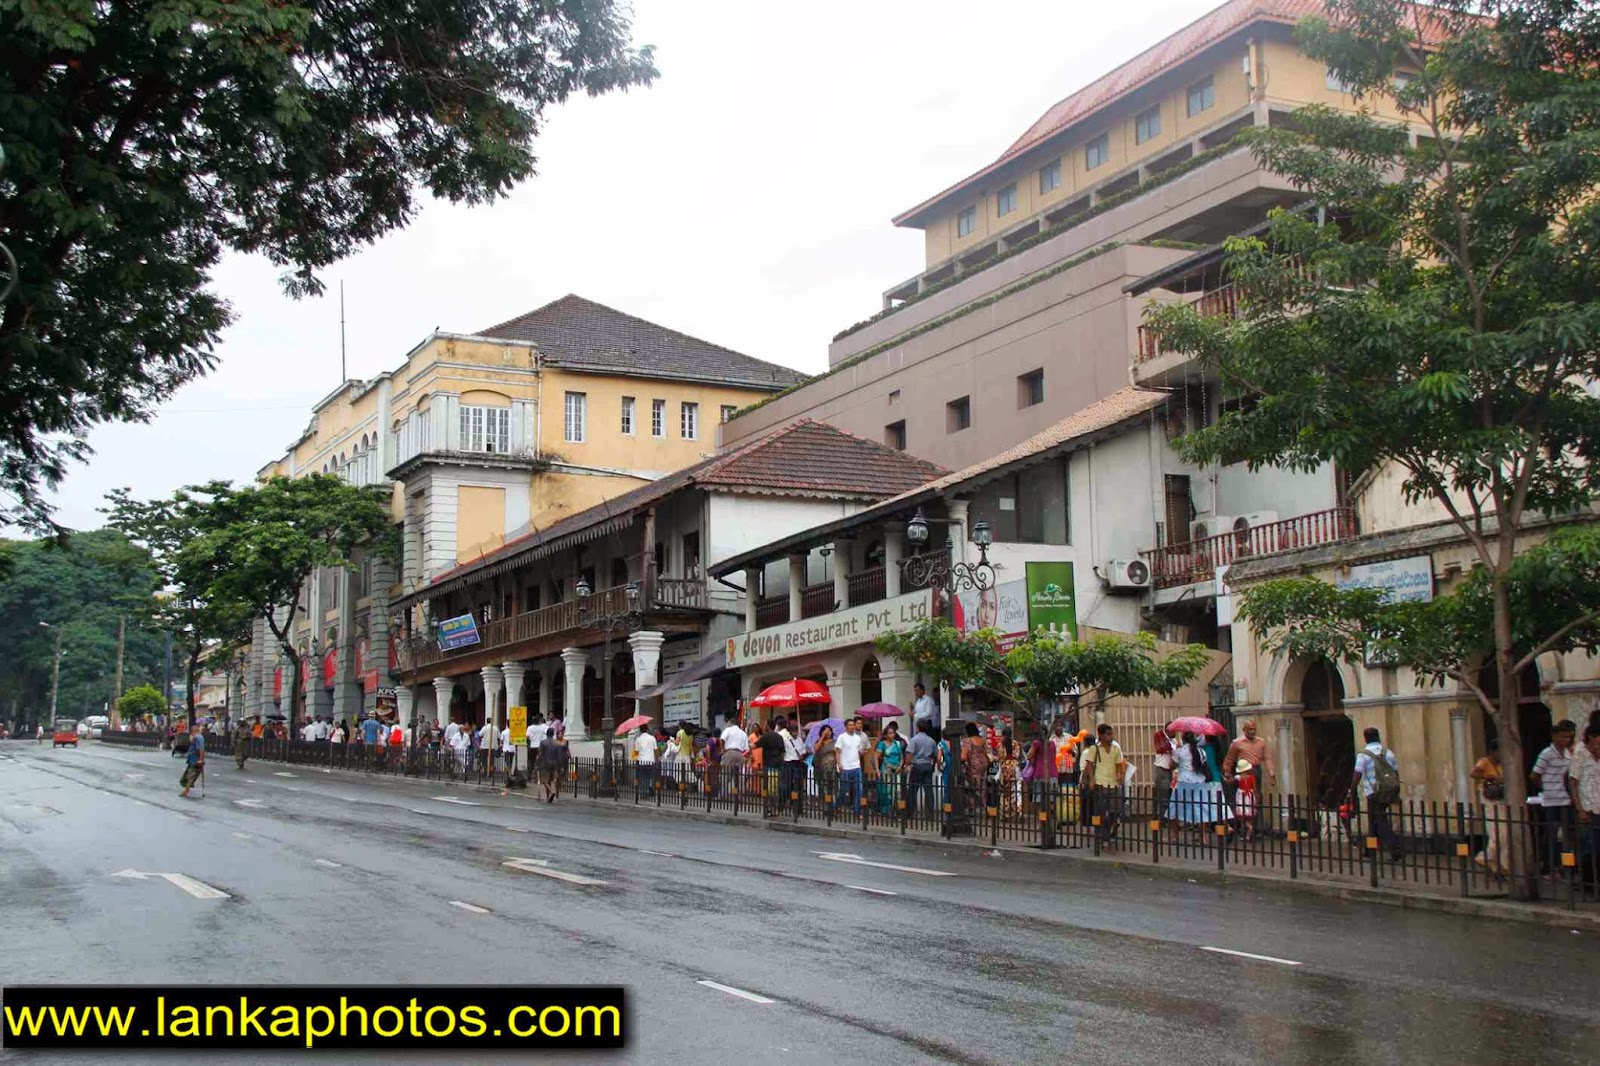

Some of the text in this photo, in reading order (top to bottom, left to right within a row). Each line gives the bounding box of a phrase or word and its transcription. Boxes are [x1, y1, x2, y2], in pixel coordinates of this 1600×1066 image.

[743, 632, 780, 658] devon
[785, 617, 858, 648] Restaurant
[866, 609, 891, 630] Pvt
[901, 595, 927, 623] Ltd
[377, 688, 396, 696] KFC
